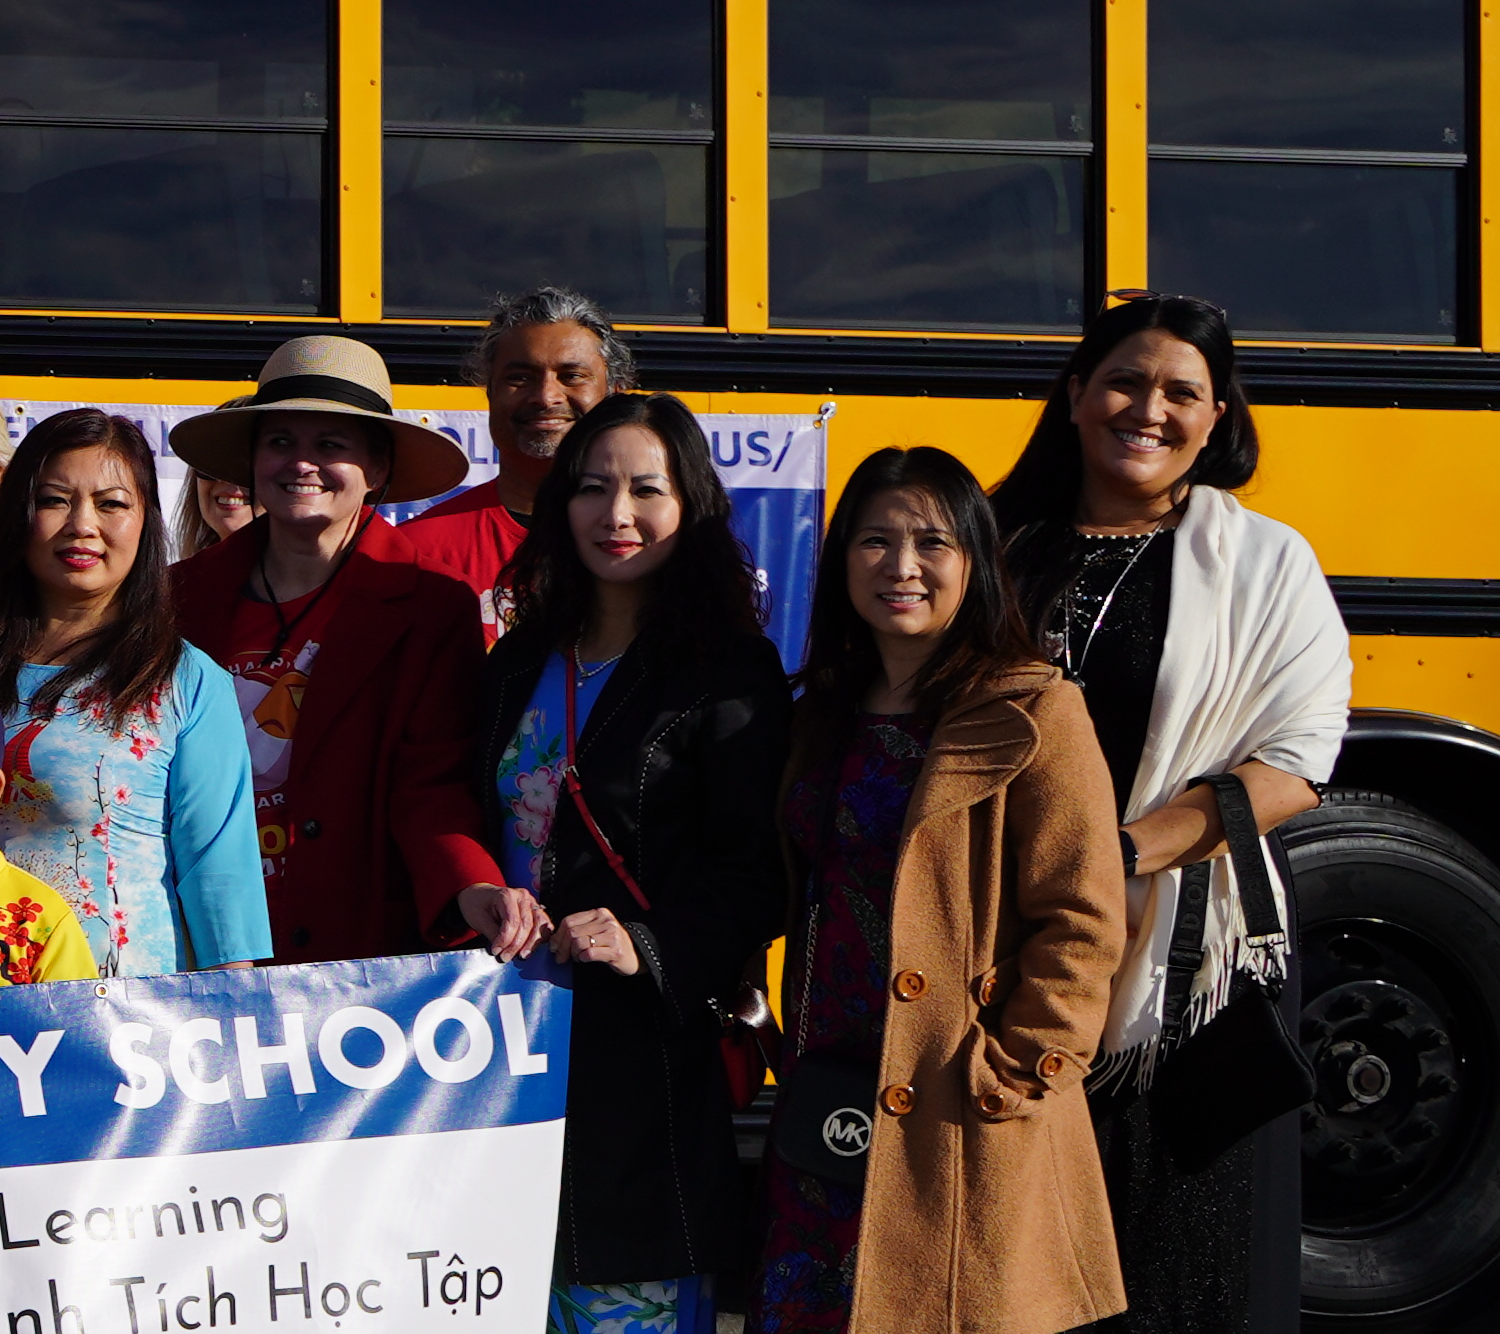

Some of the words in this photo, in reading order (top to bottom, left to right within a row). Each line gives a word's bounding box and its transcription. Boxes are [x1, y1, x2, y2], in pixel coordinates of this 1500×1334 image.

[712, 431, 794, 472] US/
[107, 992, 548, 1108] SCHOOL
[110, 1266, 238, 1334] Tích
[269, 1262, 383, 1327] Học
[407, 1250, 502, 1316] Tập
